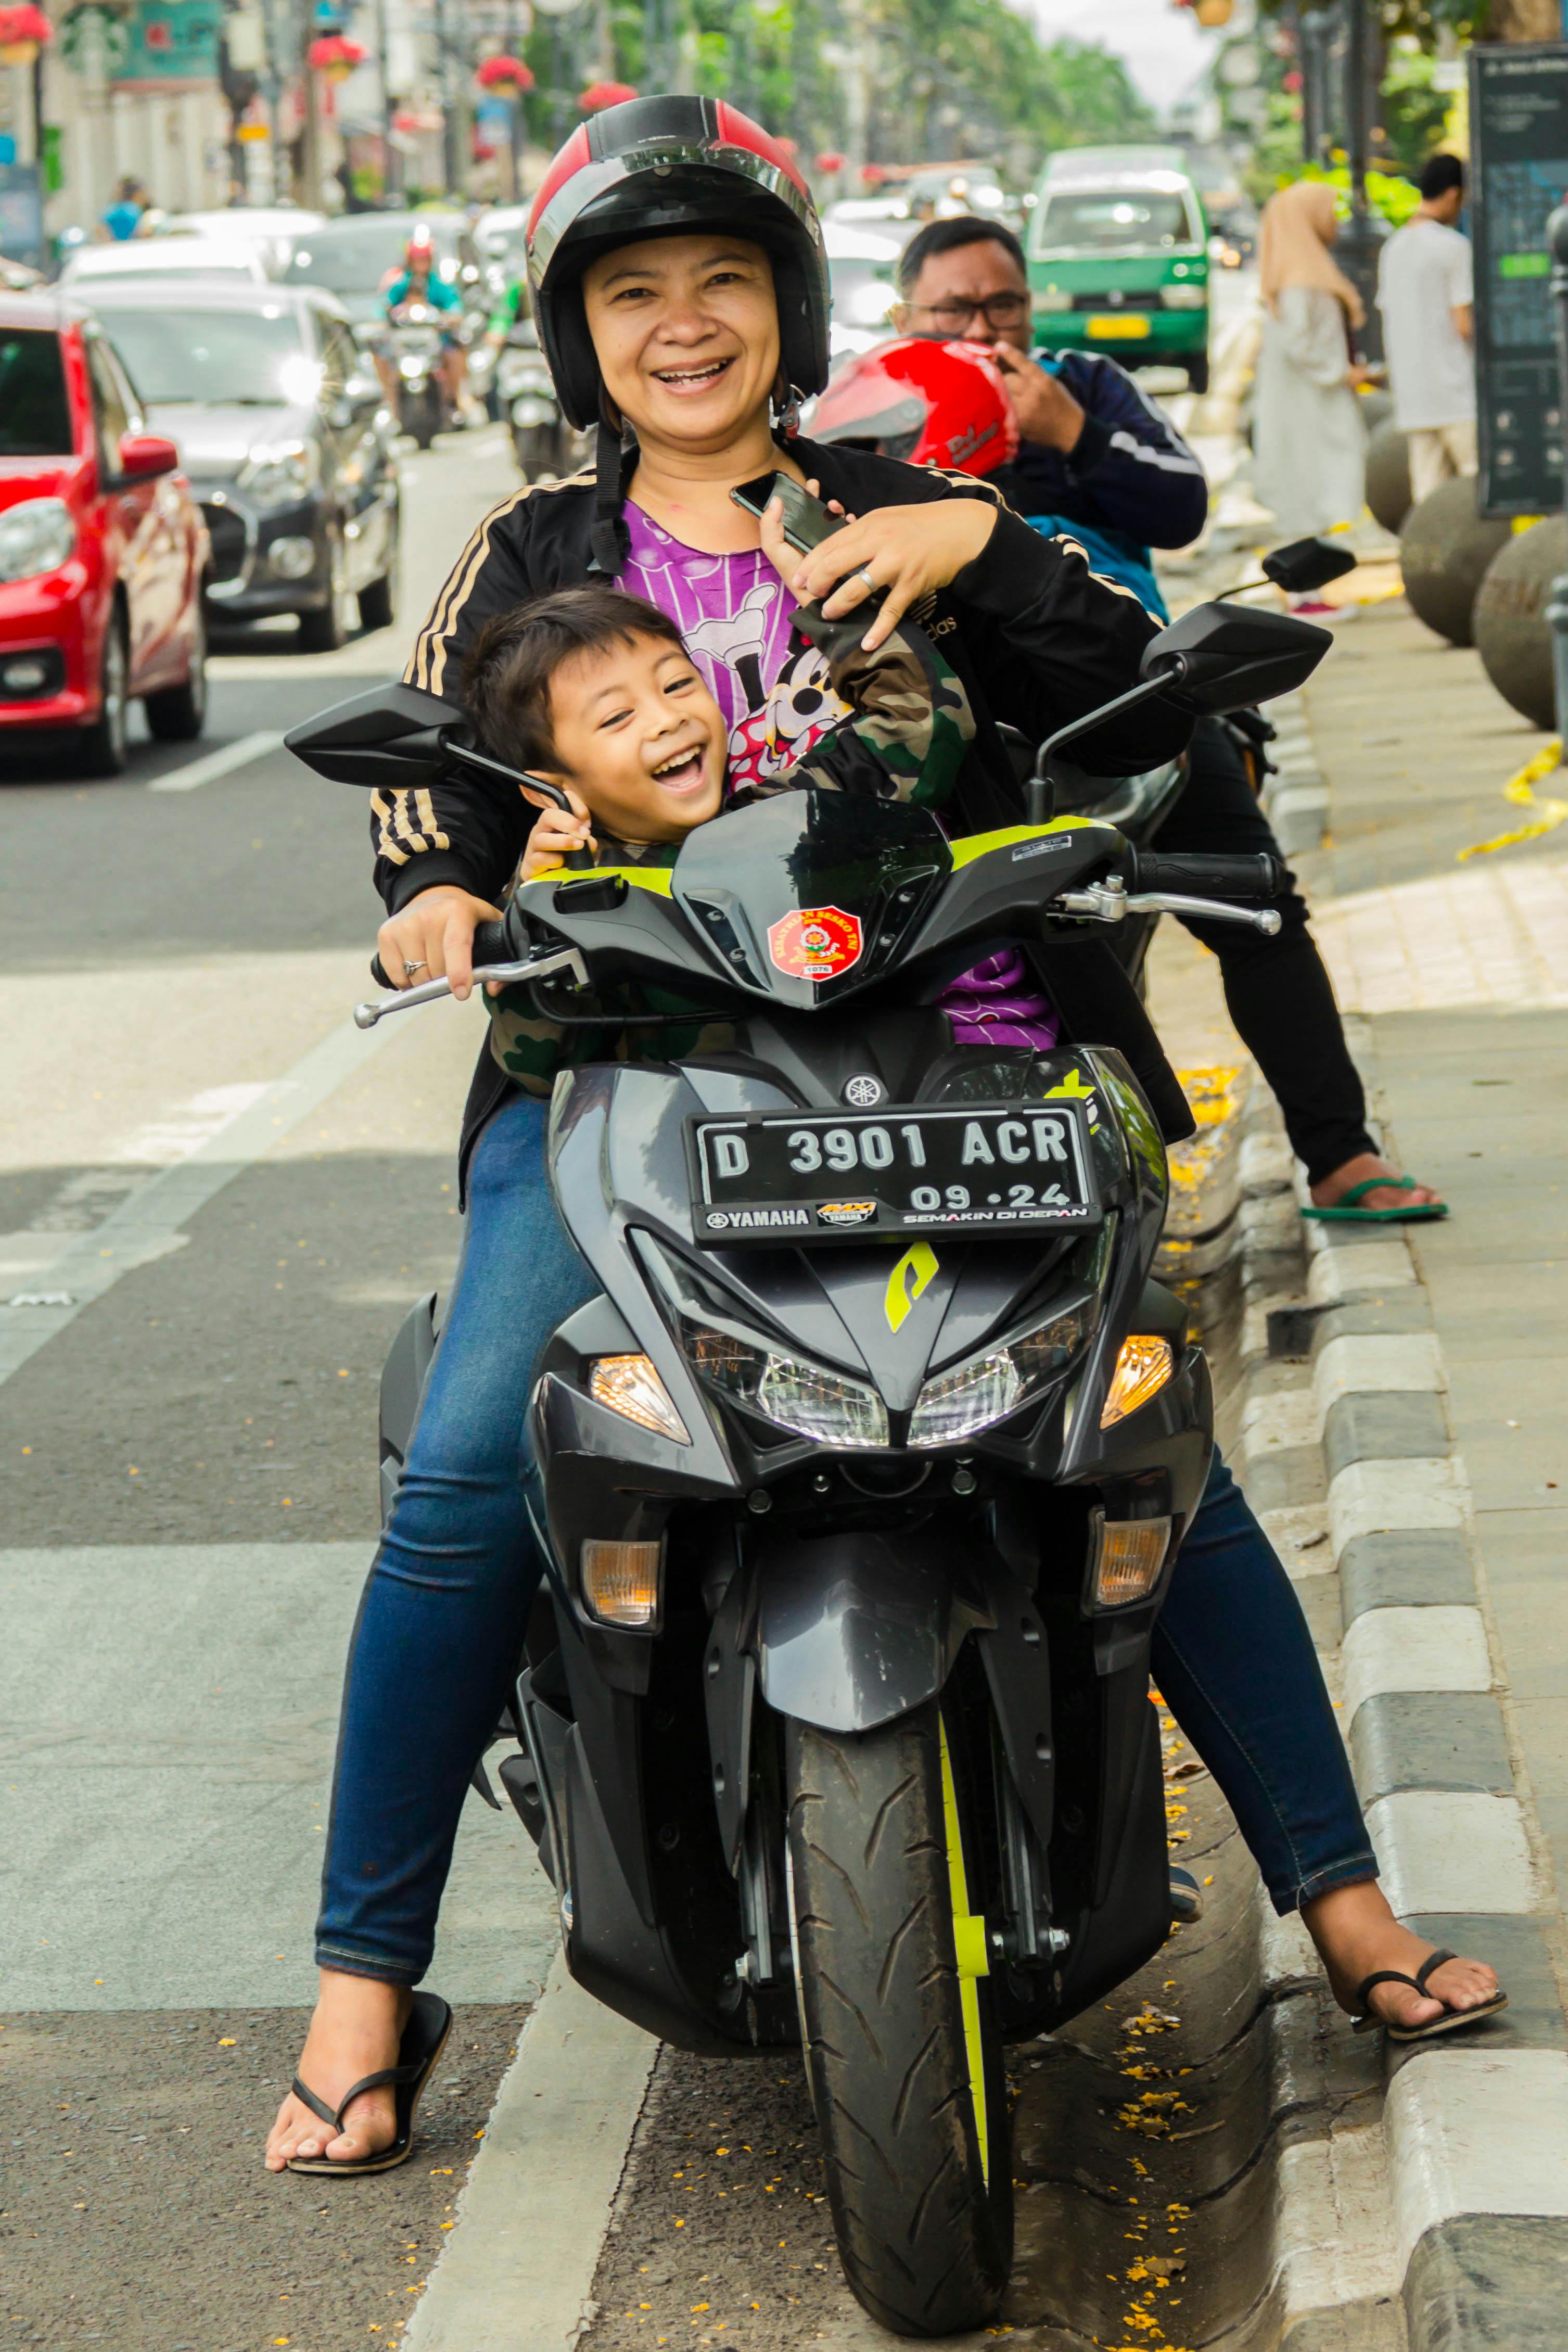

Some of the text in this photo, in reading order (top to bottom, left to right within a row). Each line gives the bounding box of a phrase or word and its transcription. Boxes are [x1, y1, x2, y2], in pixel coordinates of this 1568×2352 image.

[816, 911, 853, 933] SESKO
[847, 932, 859, 951] TNI
[713, 1118, 1068, 1178] D 3901 ACR
[728, 1210, 810, 1227] YAMAHA
[1018, 1207, 1088, 1219] DEPAN
